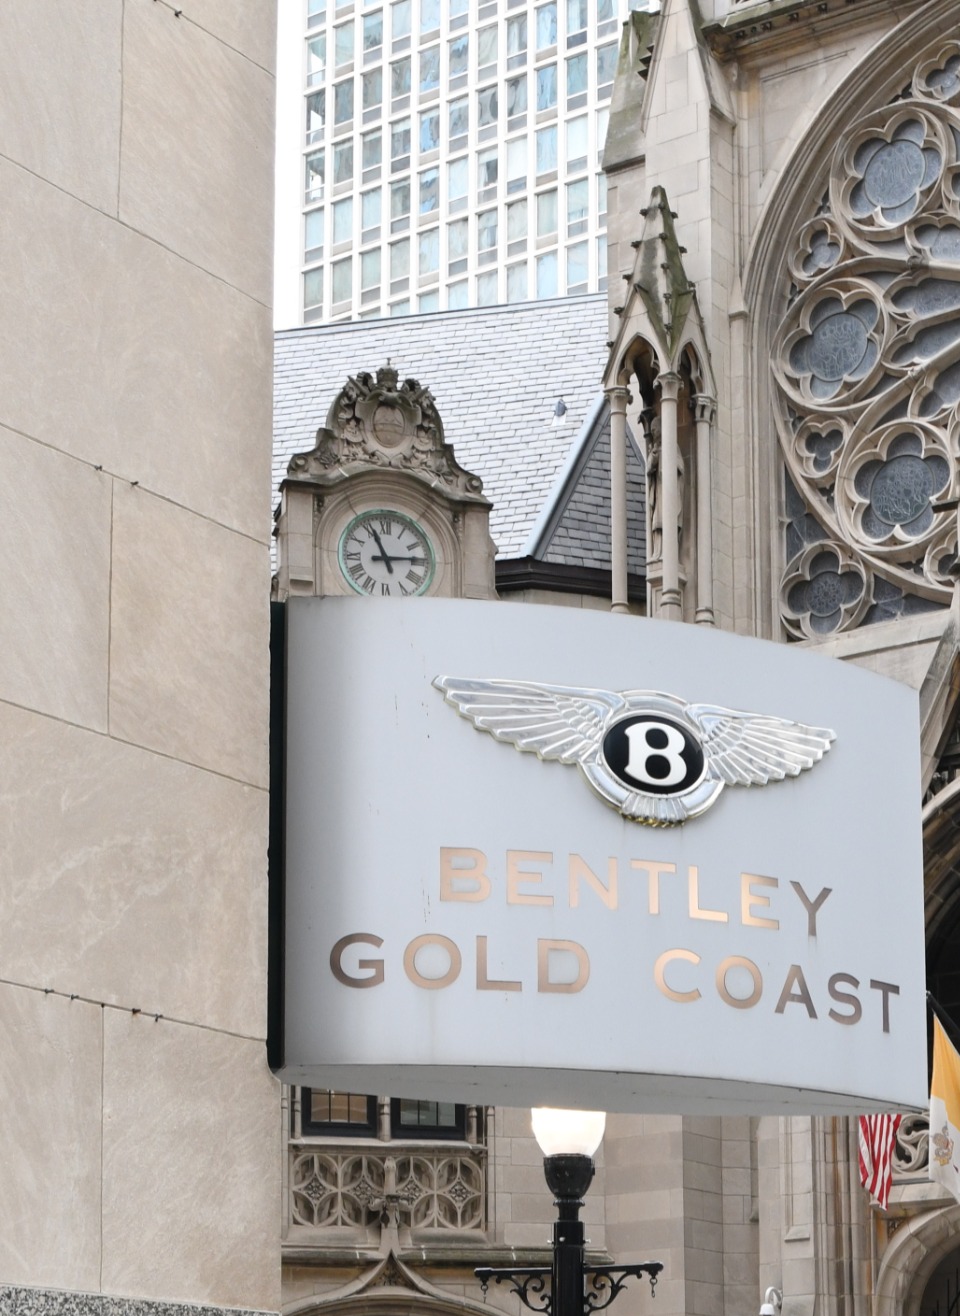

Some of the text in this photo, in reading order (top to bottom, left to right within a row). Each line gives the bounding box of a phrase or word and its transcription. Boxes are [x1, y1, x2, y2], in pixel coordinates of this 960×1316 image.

[380, 520, 392, 535] XII
[623, 720, 687, 785] B
[440, 846, 833, 937] BENTLEY
[329, 932, 900, 1034] GOLD COAST
